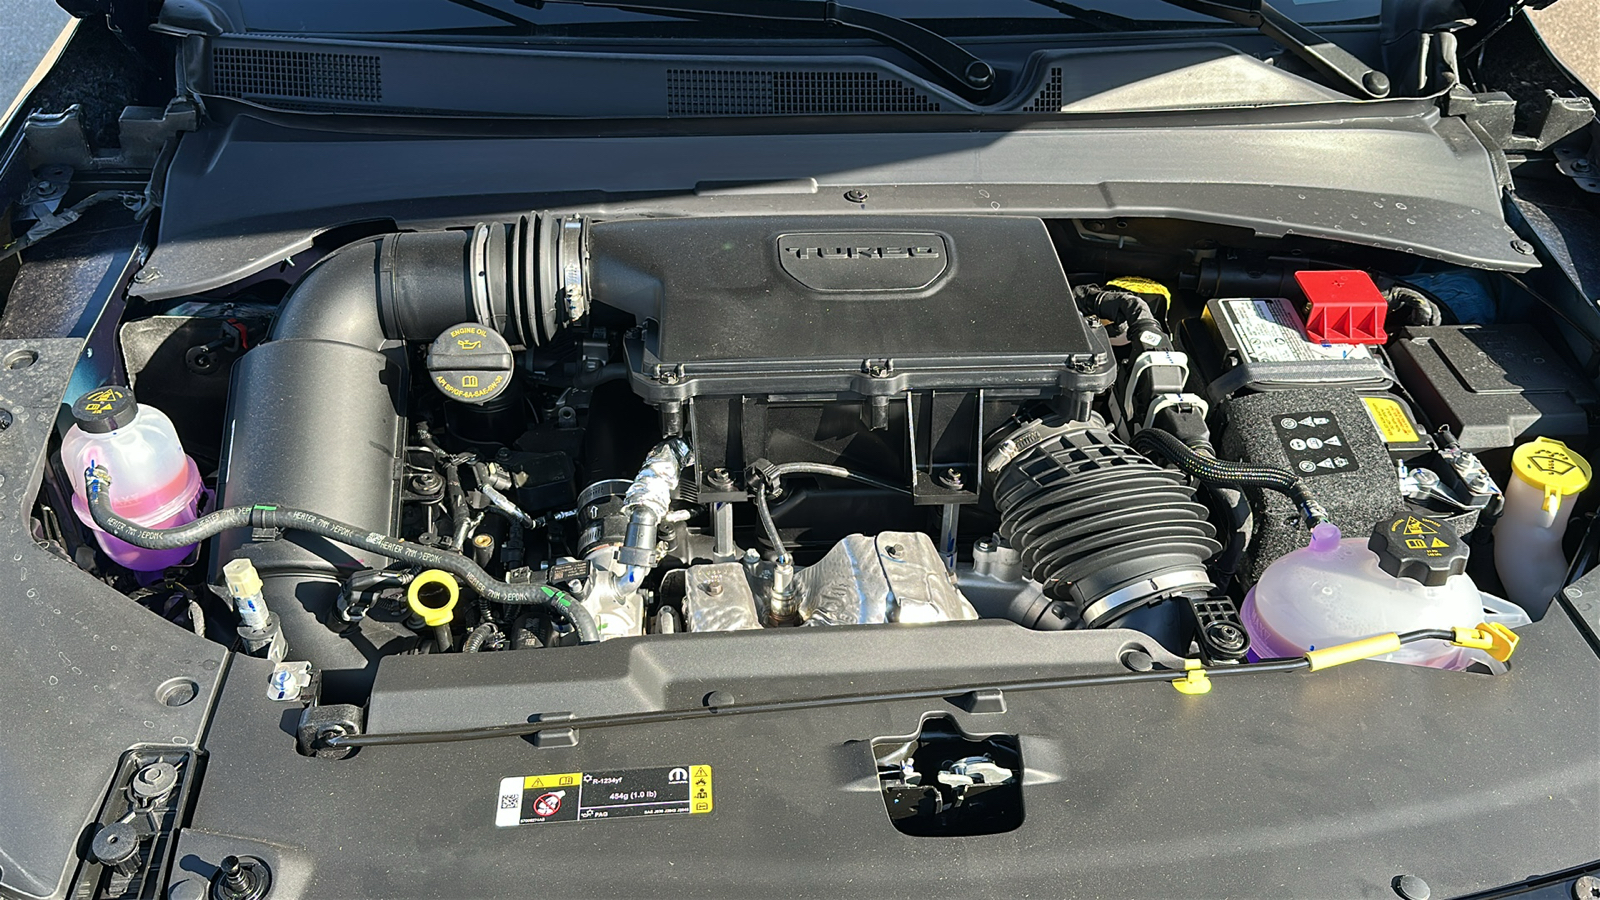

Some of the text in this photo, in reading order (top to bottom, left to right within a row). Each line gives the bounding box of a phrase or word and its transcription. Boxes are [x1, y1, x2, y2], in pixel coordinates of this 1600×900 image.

[784, 247, 940, 259] TURBO
[450, 328, 487, 338] ENGINE OIL
[436, 376, 445, 387] API
[107, 516, 126, 531] HEATER
[196, 512, 220, 527] HEATER
[293, 511, 317, 525] HEATER
[317, 518, 330, 529] 7MM
[380, 540, 404, 554] HEATER
[405, 547, 418, 558] 7MM
[466, 572, 486, 592] HEATER
[487, 588, 501, 600] 7MM
[592, 776, 622, 785] R-1234yf
[609, 790, 657, 801] 454g (1.0 lb)
